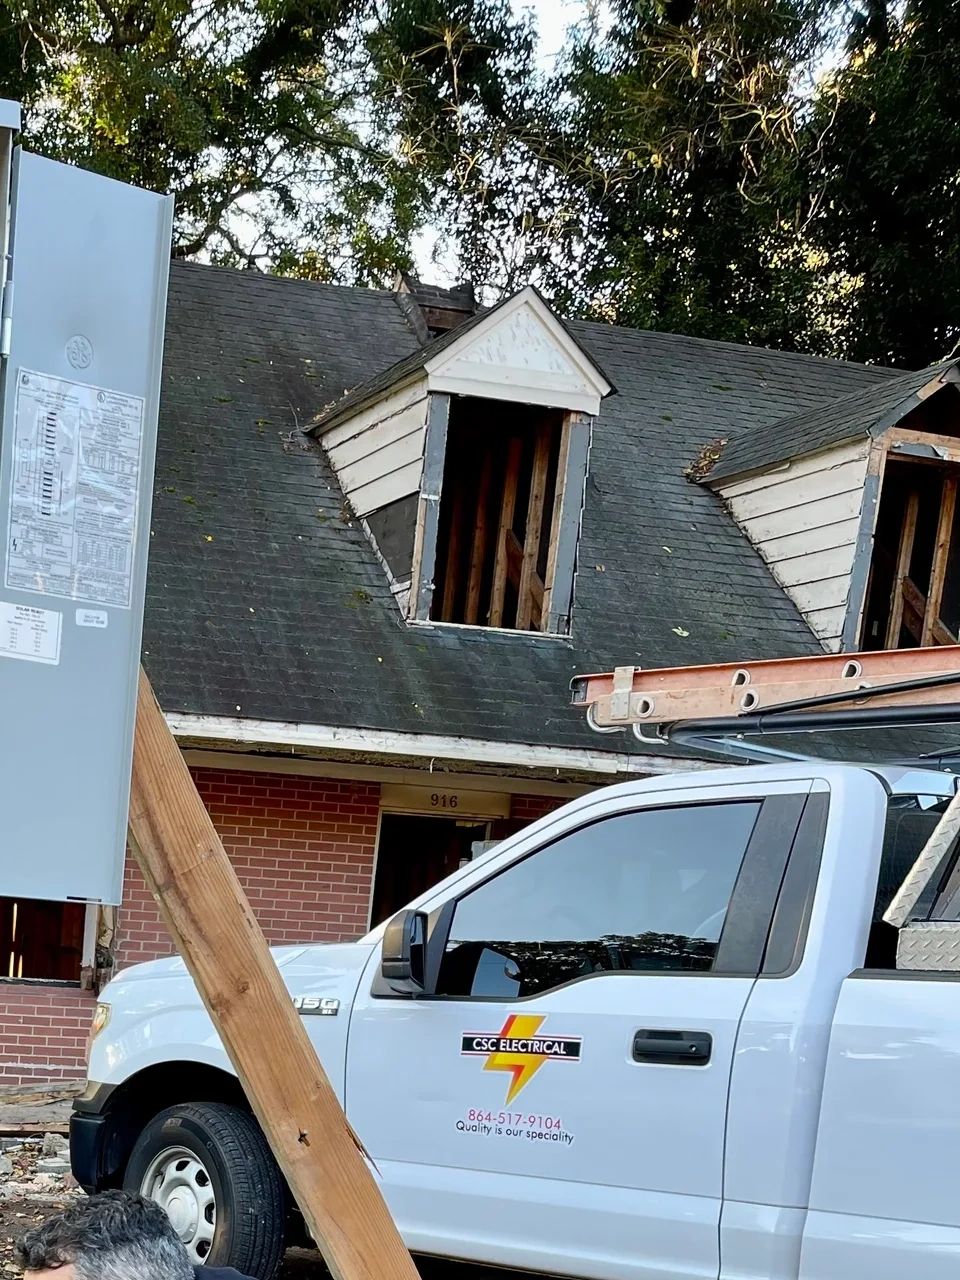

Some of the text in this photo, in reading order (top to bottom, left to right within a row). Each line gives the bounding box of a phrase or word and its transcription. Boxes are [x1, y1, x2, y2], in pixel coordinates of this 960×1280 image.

[431, 793, 458, 808] 916
[473, 1038, 567, 1055] CSC ELECTRICAL
[468, 1109, 561, 1130] 864-517-9104
[456, 1120, 574, 1145] Quality is our speciality
